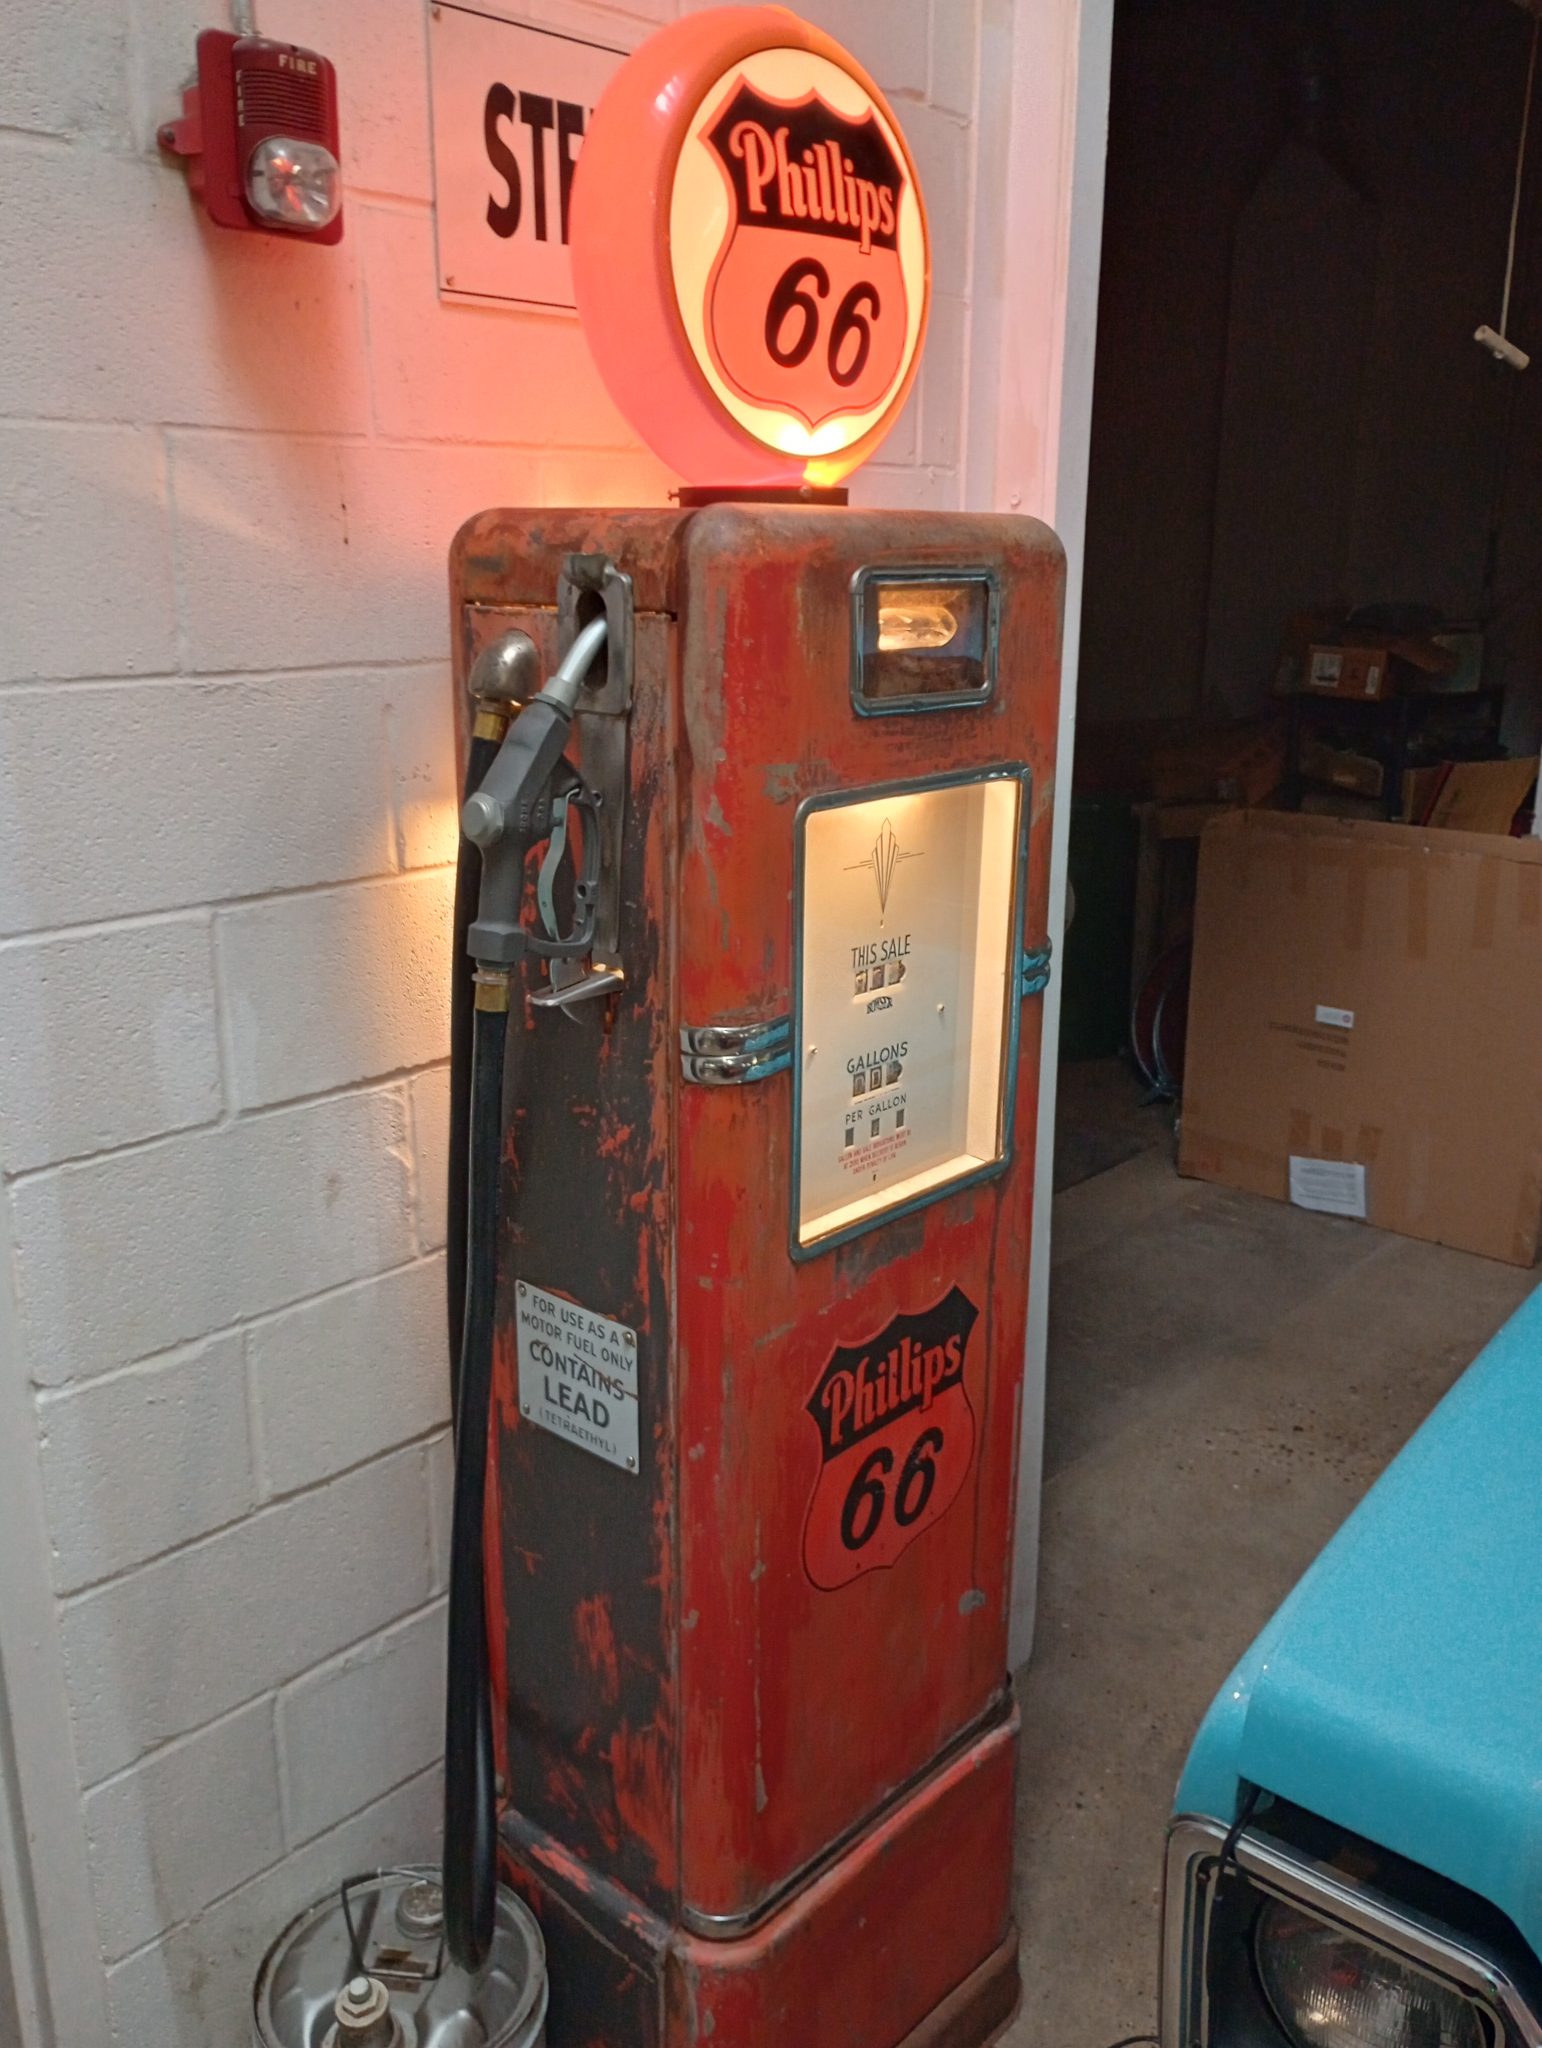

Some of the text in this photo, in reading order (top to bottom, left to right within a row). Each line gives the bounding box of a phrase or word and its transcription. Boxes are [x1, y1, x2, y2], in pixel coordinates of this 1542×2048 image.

[279, 53, 318, 76] FIRE
[484, 81, 594, 245] ST
[729, 120, 896, 255] Phillips
[765, 257, 881, 387] 66
[851, 934, 911, 969] THIS SALE
[846, 1041, 908, 1074] GALLONS
[845, 1110, 863, 1125] PER
[868, 1093, 907, 1116] GALLON
[521, 1311, 633, 1372] MOTOR FUEL ONLY
[533, 1295, 619, 1346] FOR USE AS A
[529, 1339, 625, 1402] CONTAINS
[822, 1333, 962, 1446] Phillips
[544, 1375, 610, 1429] LEAD
[539, 1407, 617, 1455] (TETRAETHYL)
[841, 1426, 944, 1550] 66
